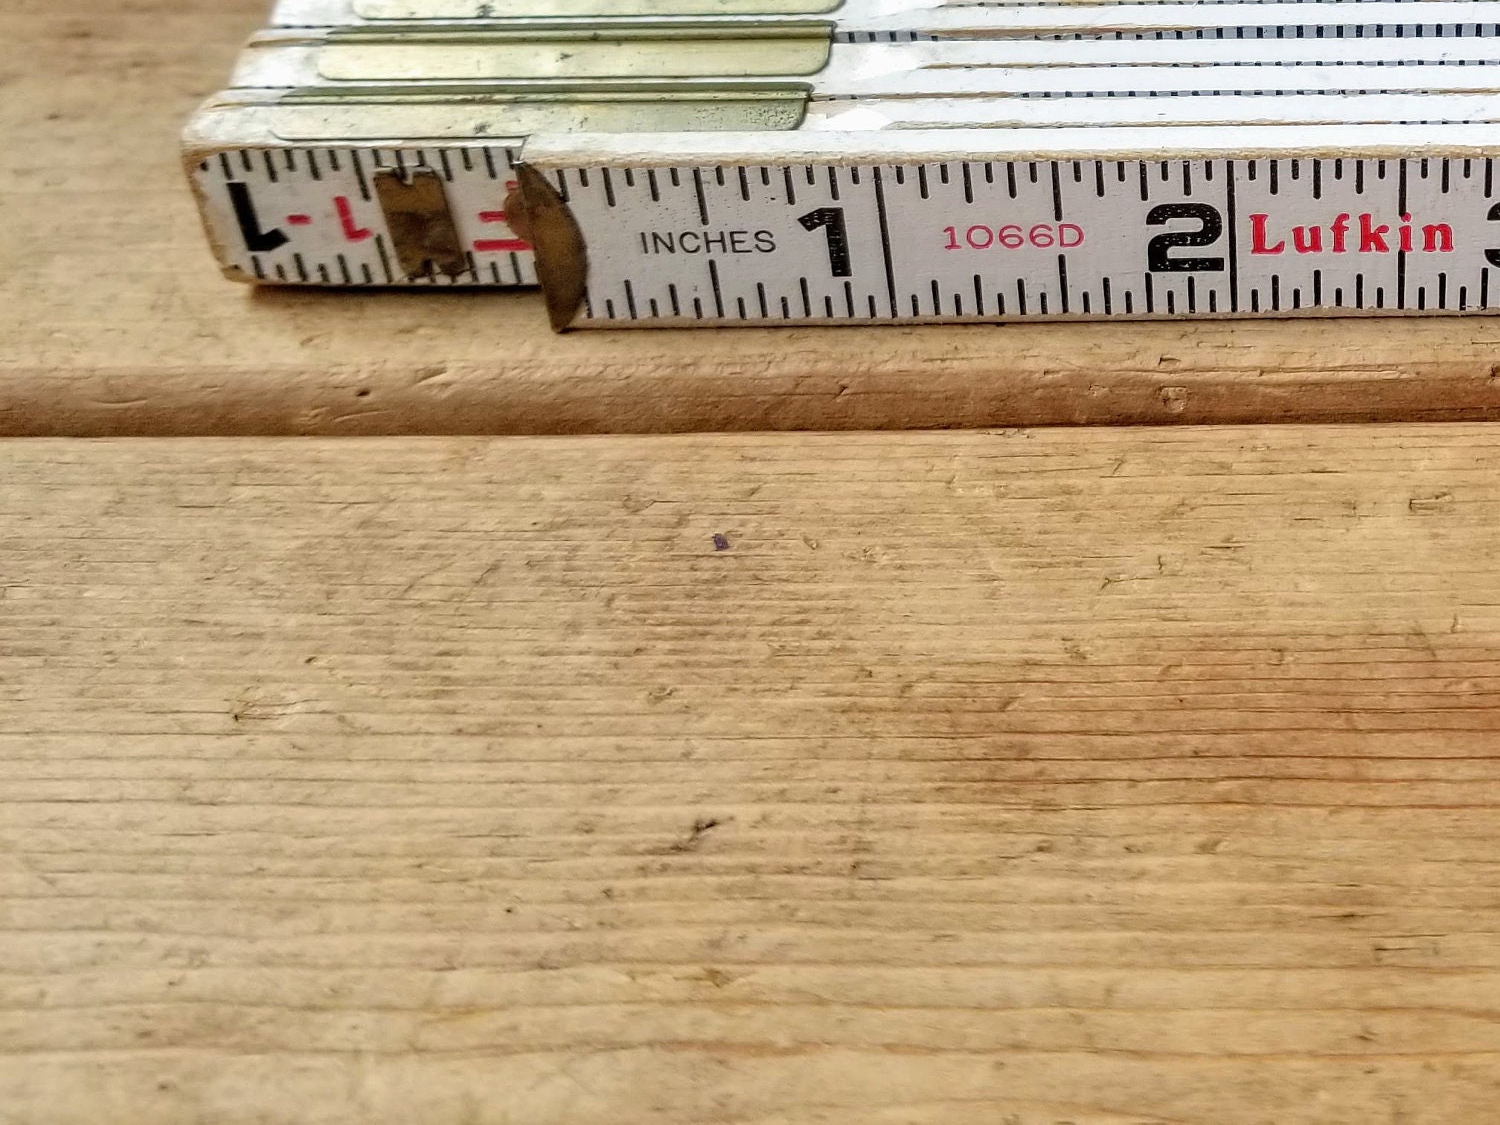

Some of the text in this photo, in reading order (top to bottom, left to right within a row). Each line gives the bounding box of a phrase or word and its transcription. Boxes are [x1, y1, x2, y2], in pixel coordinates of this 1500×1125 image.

[640, 230, 776, 254] INCHES
[797, 206, 852, 277] 1
[943, 223, 1085, 251] 1066D
[1145, 202, 1225, 273] 2
[1249, 211, 1454, 255] Lufkin
